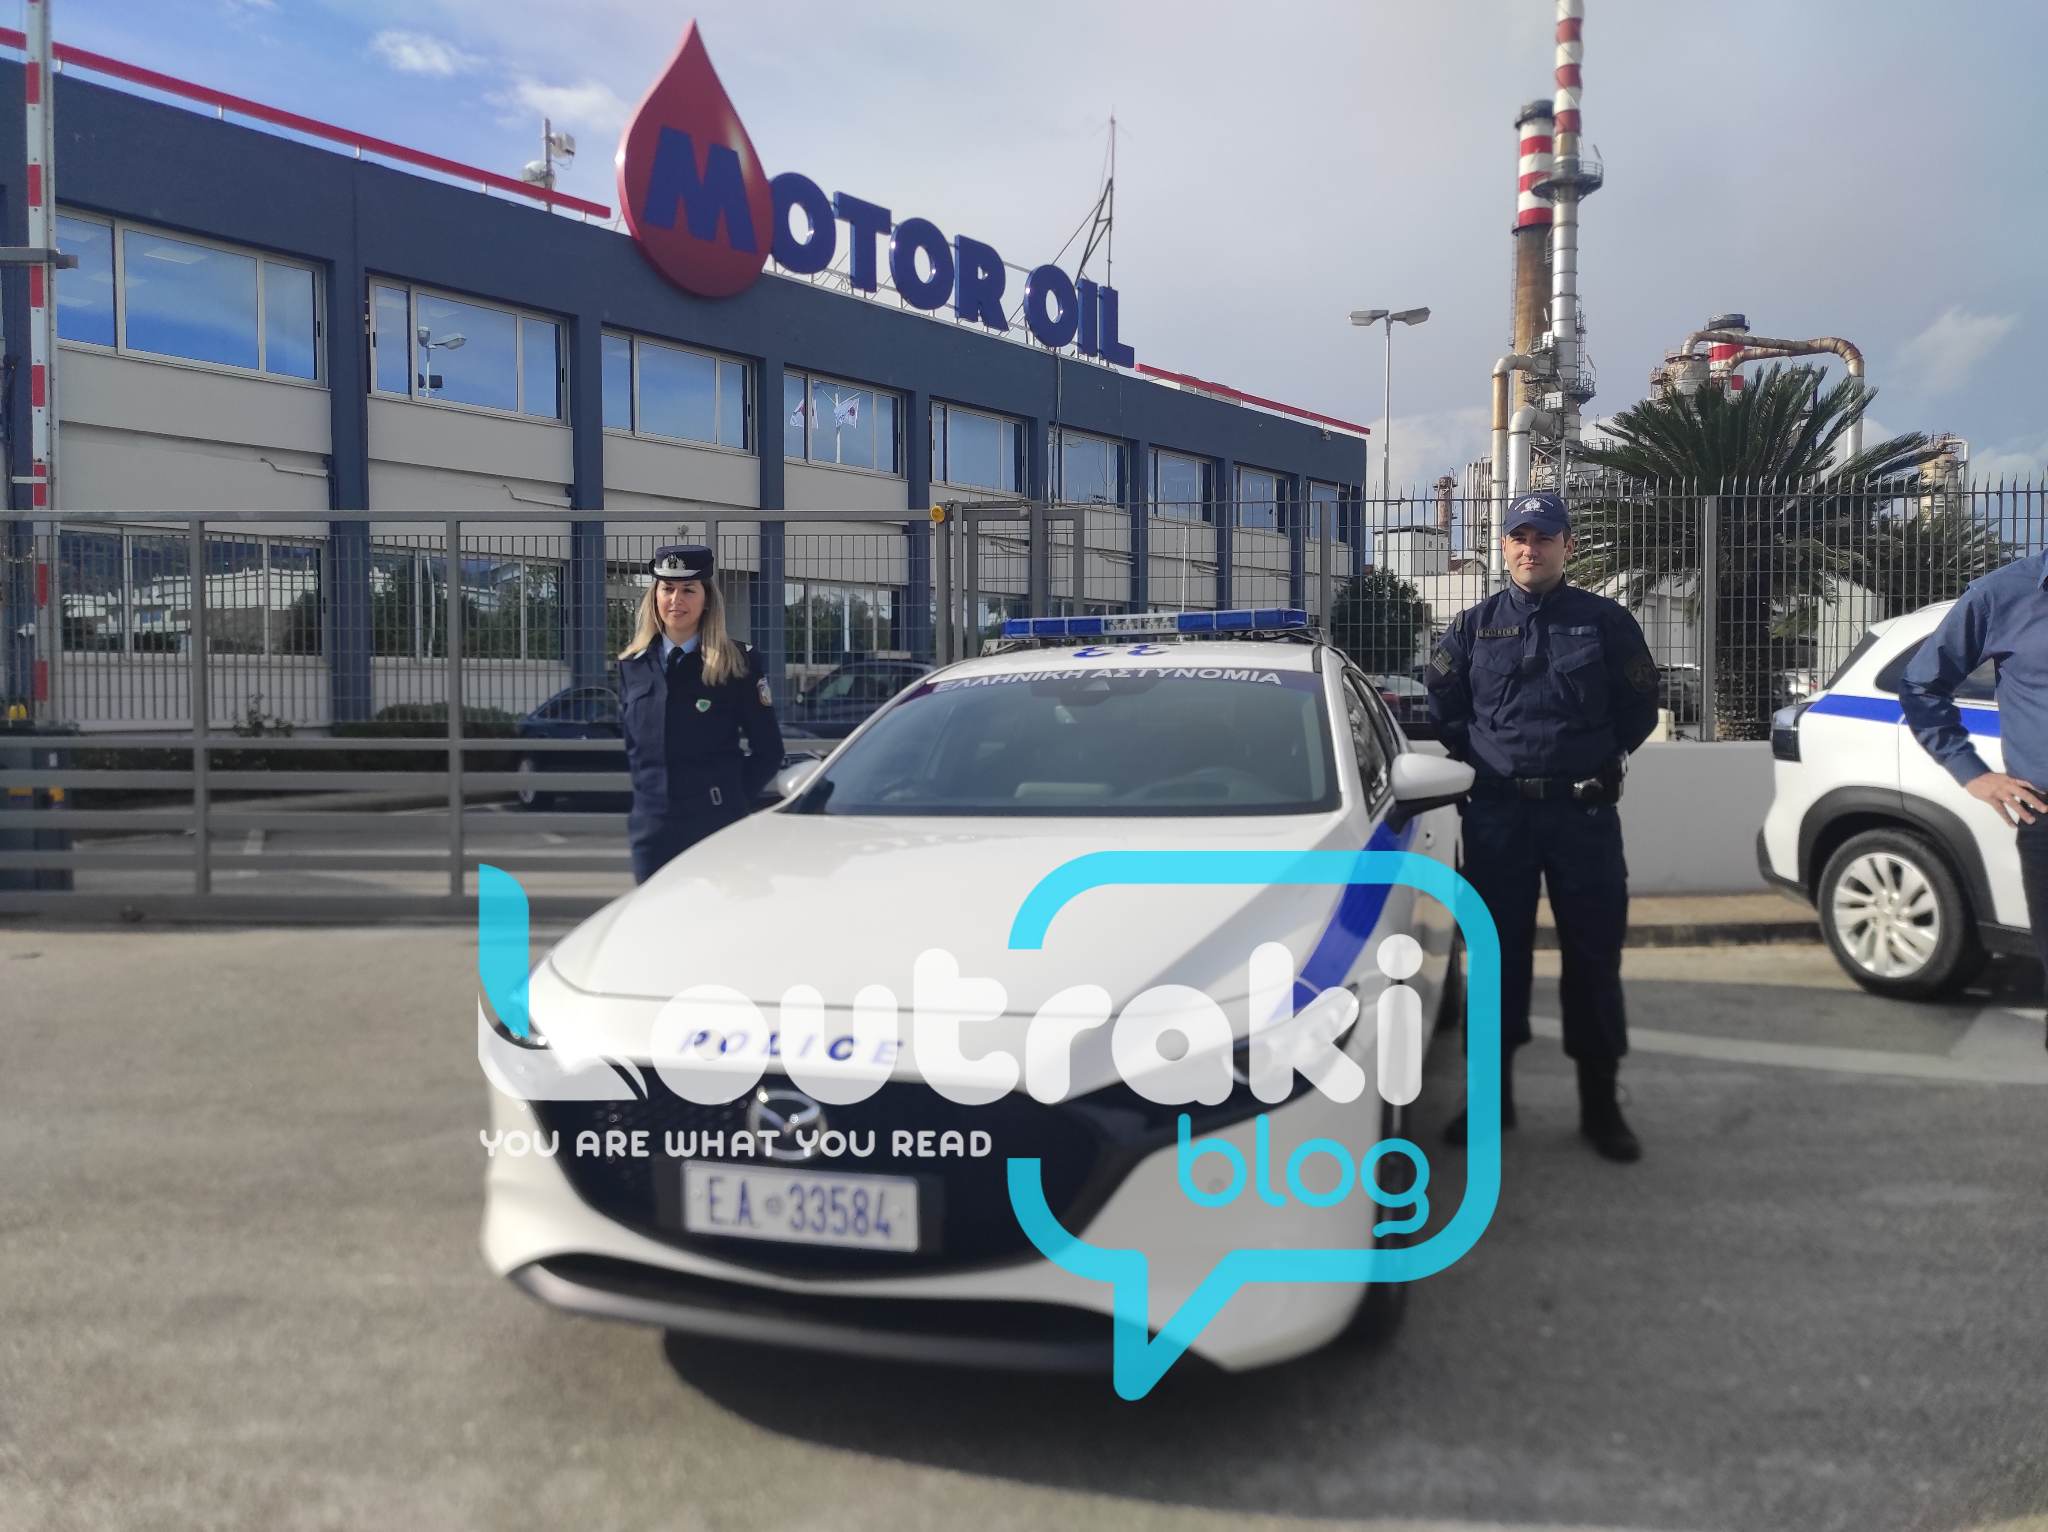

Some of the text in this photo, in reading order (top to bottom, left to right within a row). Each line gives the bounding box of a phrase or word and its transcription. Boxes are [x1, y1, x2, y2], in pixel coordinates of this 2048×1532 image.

[643, 125, 1135, 368] MOTOR OIL
[933, 668, 1283, 693] ΕΛΛΗΝΙΚΗ ΑΣΤΥΝΟΜΙΑ
[678, 1029, 904, 1065] POLICE
[788, 1182, 892, 1238] 33584
